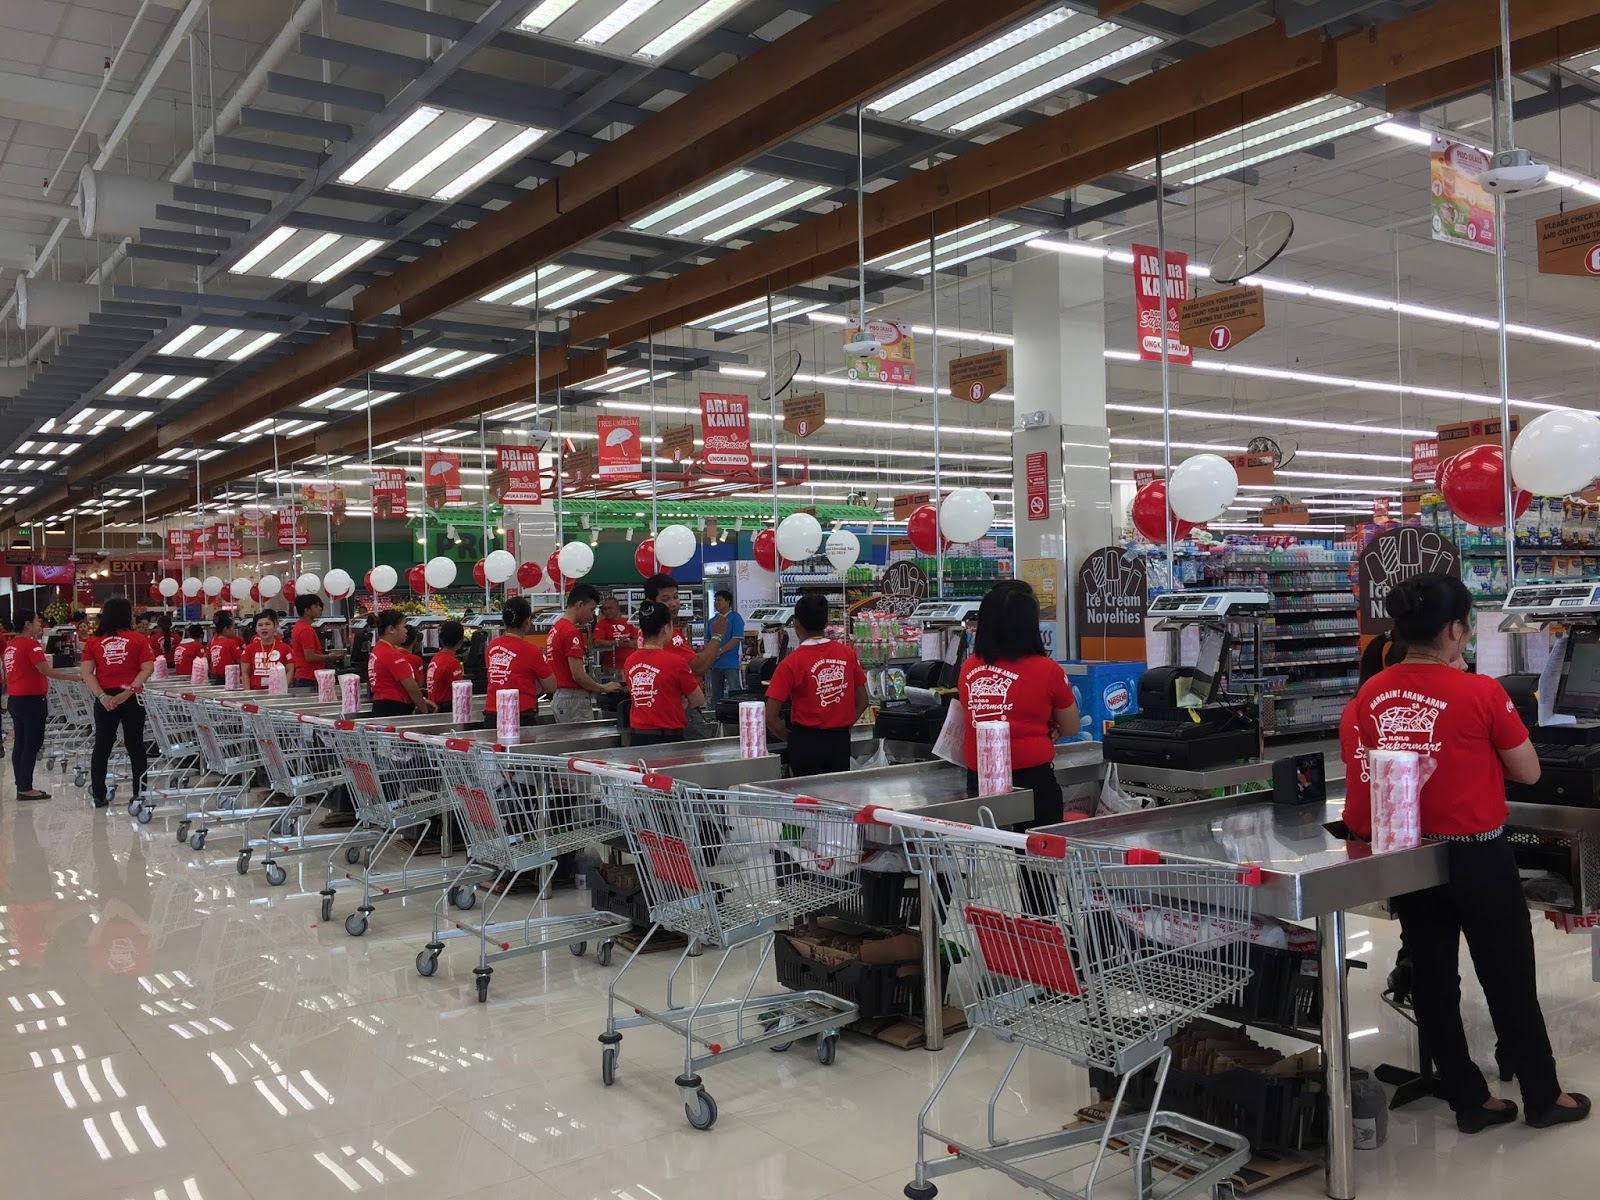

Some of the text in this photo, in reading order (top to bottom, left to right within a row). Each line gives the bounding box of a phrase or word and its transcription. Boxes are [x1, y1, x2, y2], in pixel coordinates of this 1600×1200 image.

[1544, 218, 1569, 230] PLEASE
[1570, 212, 1594, 224] CHECK
[1543, 232, 1556, 240] AND
[1558, 225, 1580, 237] COUNT
[1562, 232, 1591, 246] LEAVING
[1167, 263, 1182, 278] na
[1220, 302, 1240, 312] CHANGE
[1214, 328, 1224, 346] 7
[972, 384, 981, 400] 8
[706, 400, 743, 413] ARI na
[706, 414, 746, 427] KAMI!
[800, 420, 806, 433] 9
[1440, 428, 1469, 440] BABY NEEDS
[1473, 424, 1480, 434] 6
[704, 438, 749, 450] Supermart
[502, 450, 534, 460] ARI na
[502, 460, 536, 472] KAMI!
[112, 562, 144, 572] EXIT
[1369, 580, 1392, 598] Ice
[1086, 592, 1141, 607] Ice Cream
[1087, 608, 1140, 624] Novelties
[966, 664, 1020, 680] BARGAIN! ARAW-ARAW
[967, 700, 1014, 712] Supermart
[1370, 689, 1448, 711] BARGAIN! ARAW-ARAW
[1377, 737, 1442, 752] Supermart
